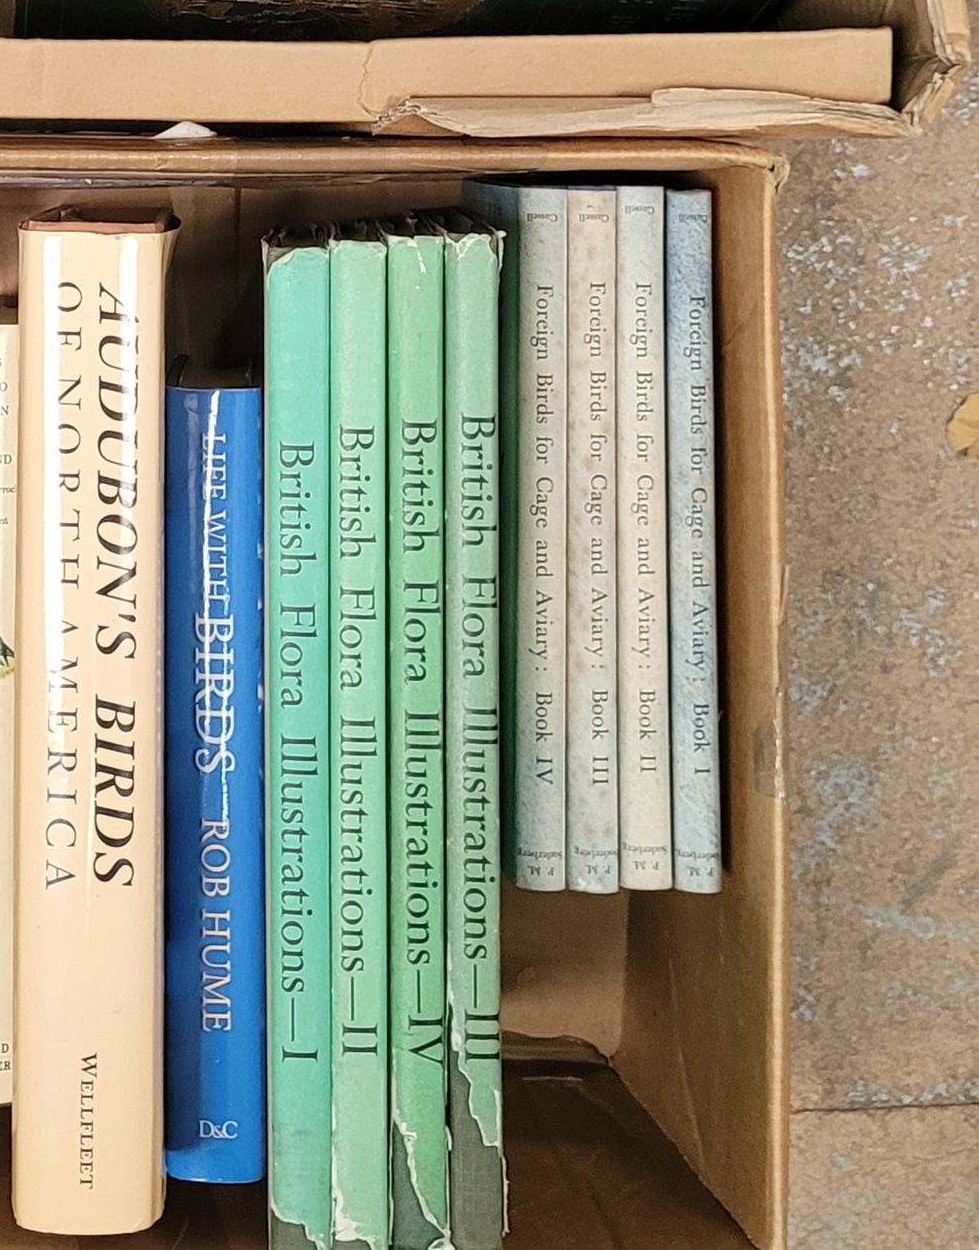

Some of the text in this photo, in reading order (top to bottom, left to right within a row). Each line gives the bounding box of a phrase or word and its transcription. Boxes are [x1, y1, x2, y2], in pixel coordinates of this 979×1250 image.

[56, 282, 83, 590] OF NORTH
[339, 424, 377, 691] British Flora
[401, 418, 441, 685] British Flora
[461, 413, 498, 679] British Flora
[530, 284, 554, 743] Foreign Birds Cage Book
[590, 371, 609, 741] Birds and Book
[629, 283, 656, 741] Foreign Birds Cage Book
[690, 385, 710, 753] Birds Book
[93, 281, 140, 888] AUDUBON'S BIRDS
[279, 441, 317, 709] British Flora
[200, 818, 232, 1033] ROB HUME
[80, 1052, 98, 1189] WELLFLEET
[199, 1120, 238, 1139] D&C
